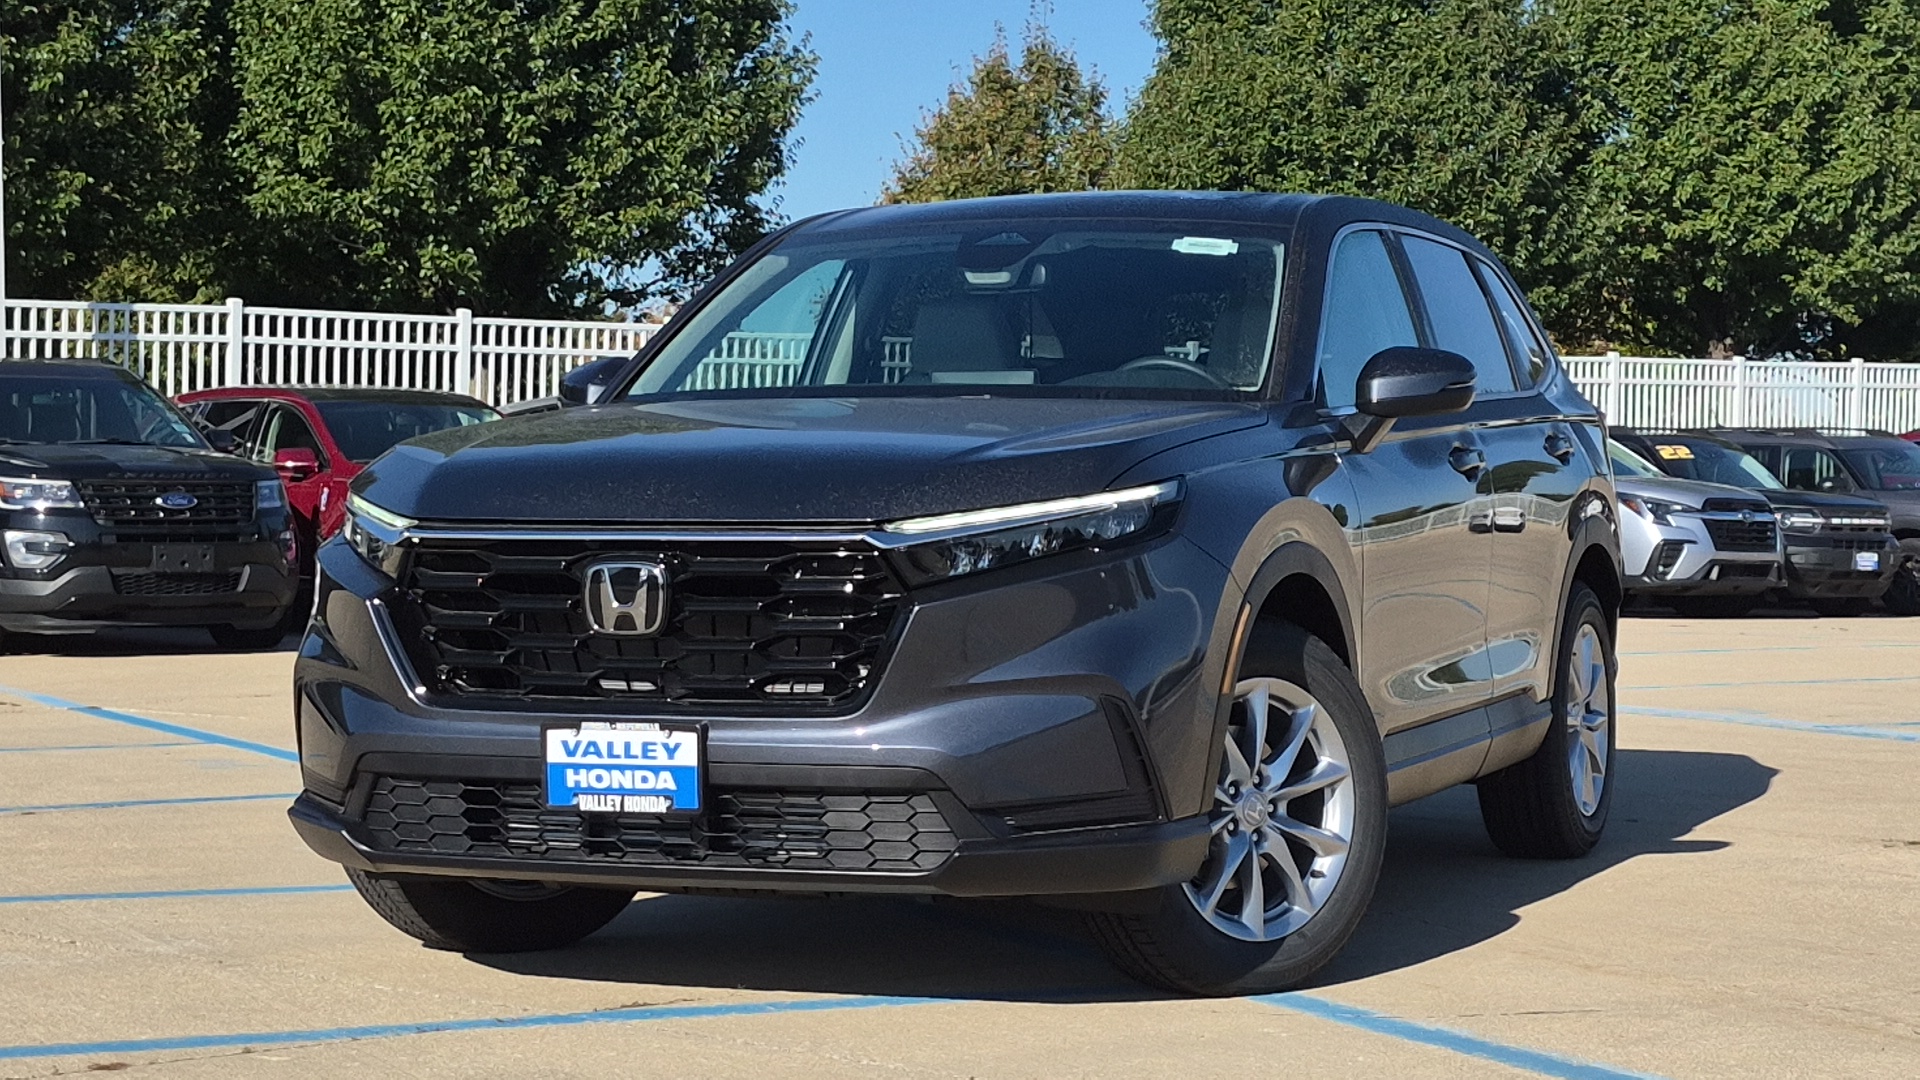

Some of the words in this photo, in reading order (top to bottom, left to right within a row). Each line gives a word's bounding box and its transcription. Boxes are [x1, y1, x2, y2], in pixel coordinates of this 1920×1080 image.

[1655, 444, 1695, 459] 22
[560, 740, 682, 760] VALLEY
[566, 768, 677, 790] HONDA
[578, 794, 622, 812] VALLEY
[623, 795, 667, 813] HONDA
